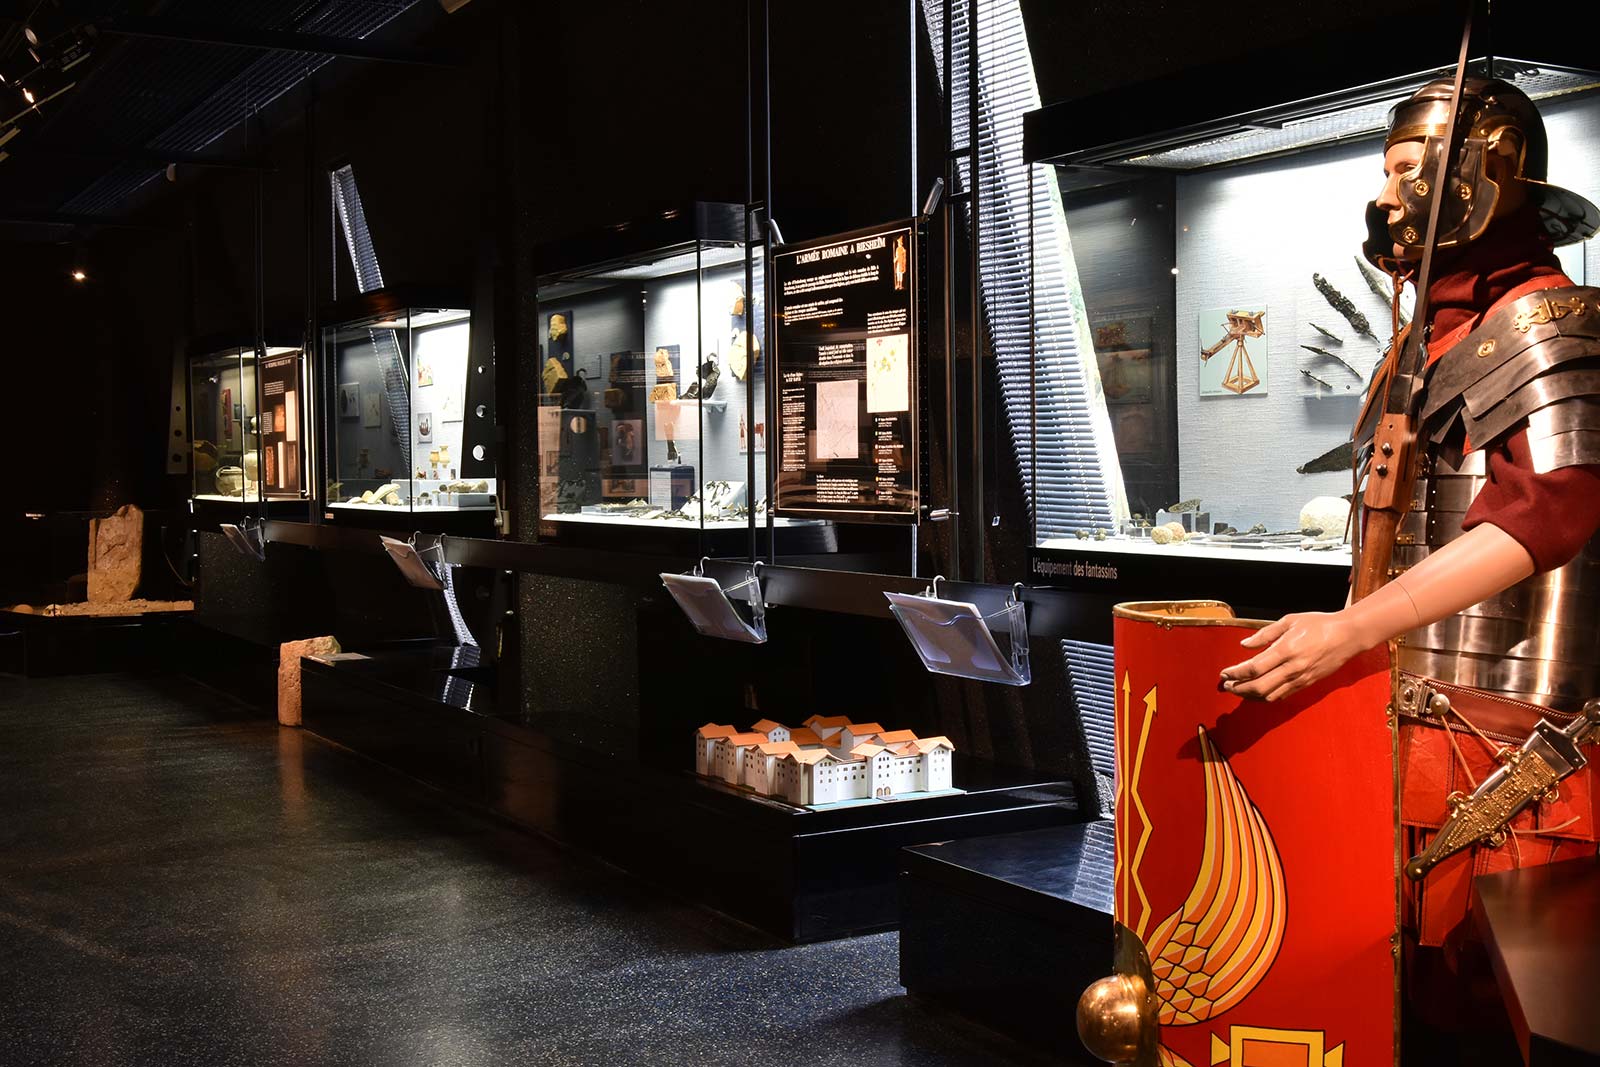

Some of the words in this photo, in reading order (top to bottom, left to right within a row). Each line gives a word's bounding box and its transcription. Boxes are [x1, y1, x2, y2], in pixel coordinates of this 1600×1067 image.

[821, 245, 848, 260] ROMAINE
[1032, 557, 1073, 578] L'équipement
[1073, 560, 1084, 577] des
[1085, 560, 1117, 580] fantassins
